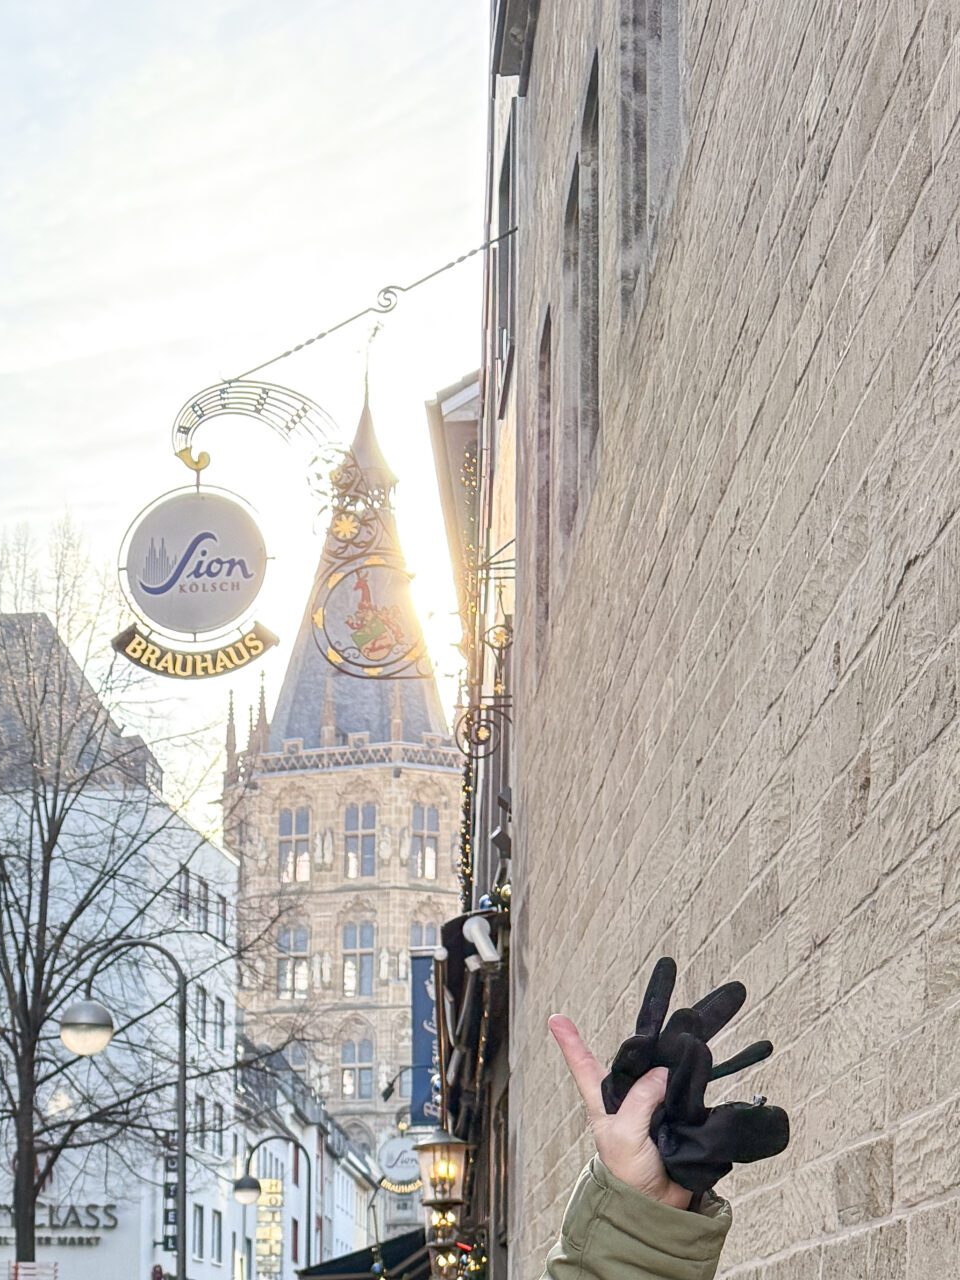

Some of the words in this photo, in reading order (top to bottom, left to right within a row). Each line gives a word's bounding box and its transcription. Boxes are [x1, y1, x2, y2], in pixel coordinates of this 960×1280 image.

[139, 531, 255, 595] Sion
[178, 581, 241, 594] KÖLSCH
[124, 632, 265, 677] BRAUHAUS
[57, 1236, 102, 1247] MARKT
